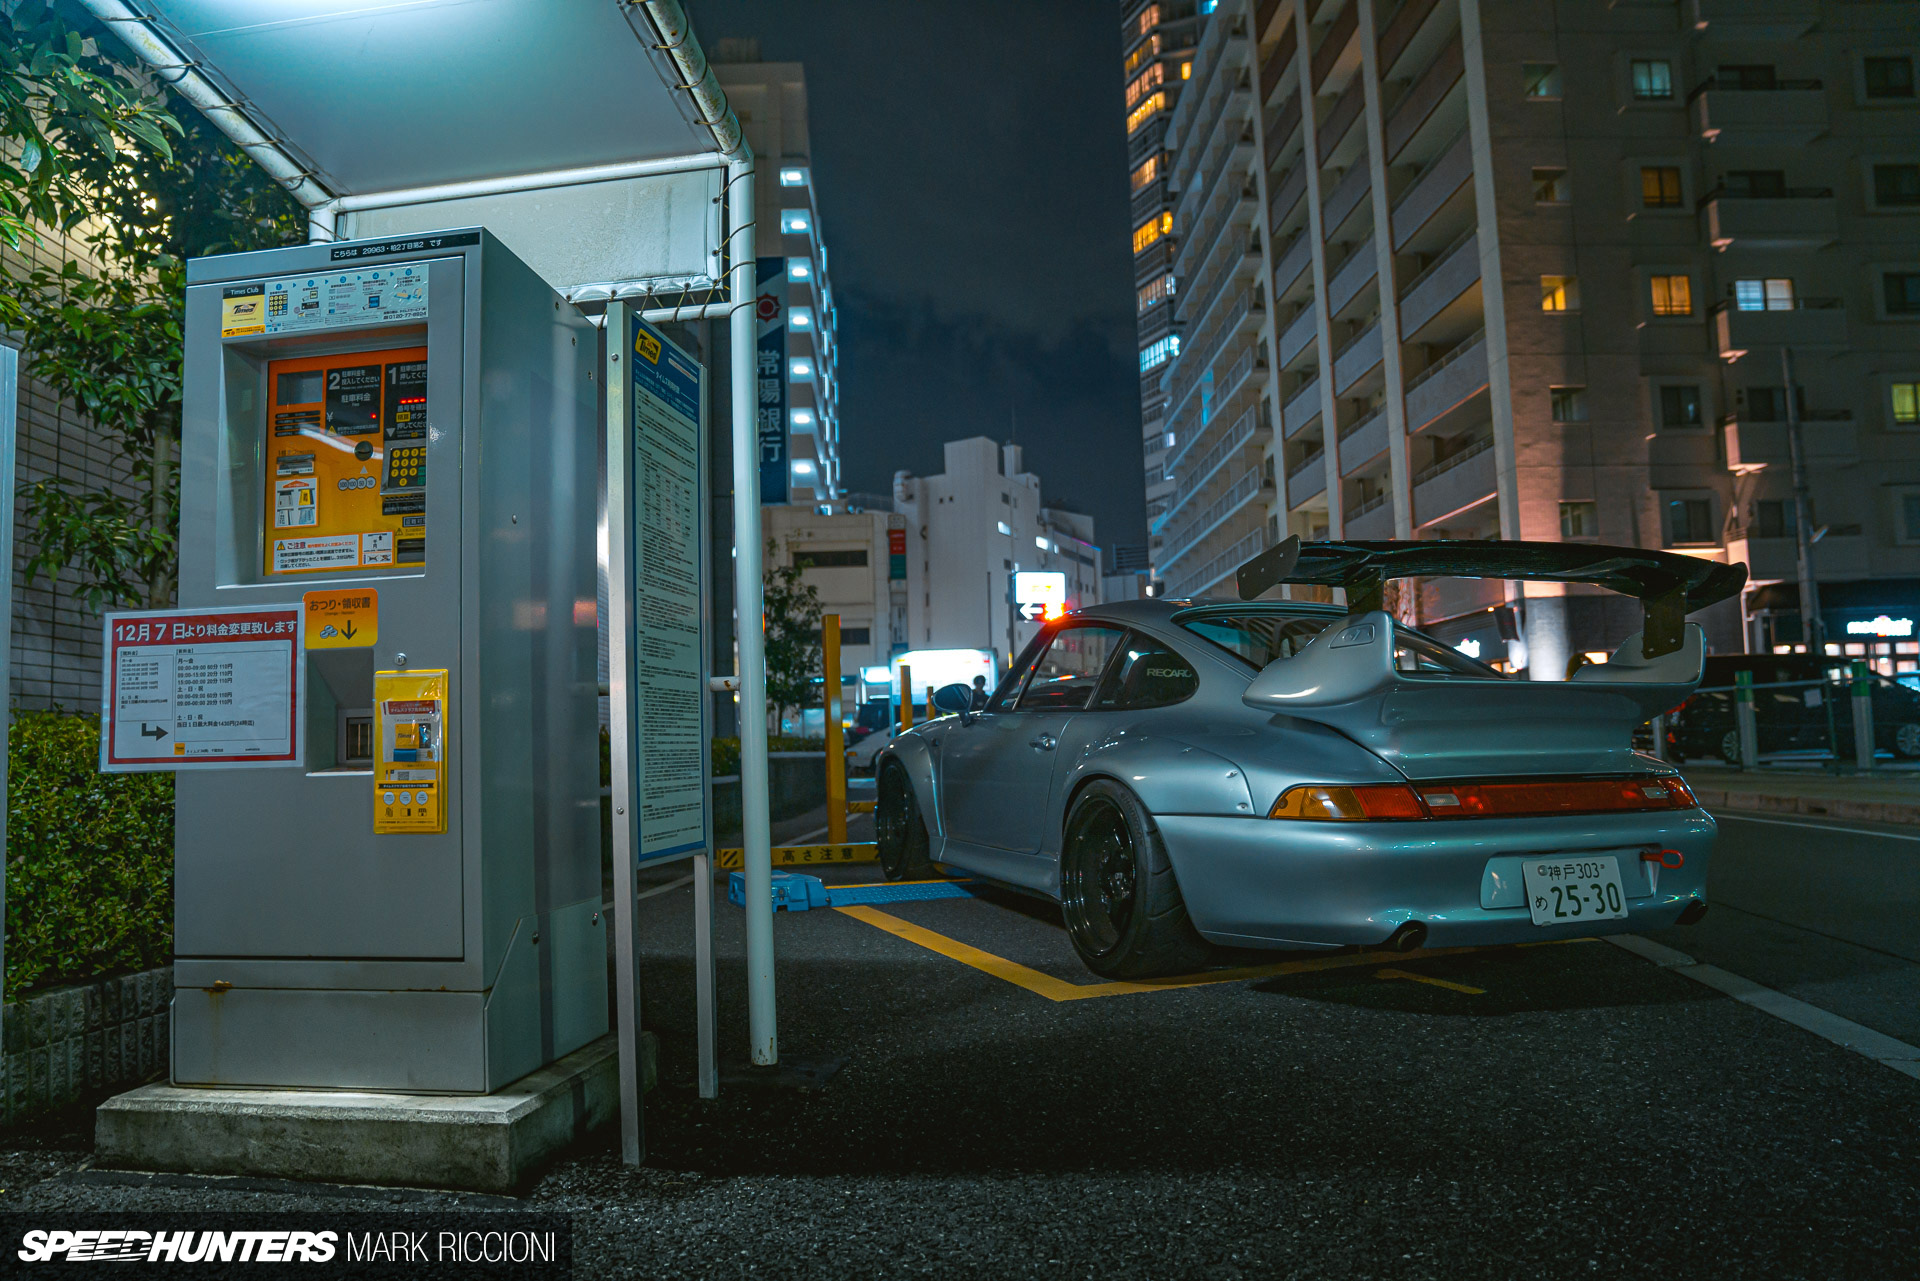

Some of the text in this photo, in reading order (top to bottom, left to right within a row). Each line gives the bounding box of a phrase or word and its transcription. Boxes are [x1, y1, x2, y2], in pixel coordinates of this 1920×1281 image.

[246, 286, 260, 294] Club
[329, 372, 341, 390] 2
[388, 366, 397, 385] 1
[341, 392, 371, 403] 駐車料金
[758, 350, 781, 463] 常陽銀行
[287, 541, 306, 550] ご注意
[309, 597, 371, 611] おつり・領収書
[782, 847, 853, 862] 高さ注意
[1535, 882, 1621, 918] め 25-30
